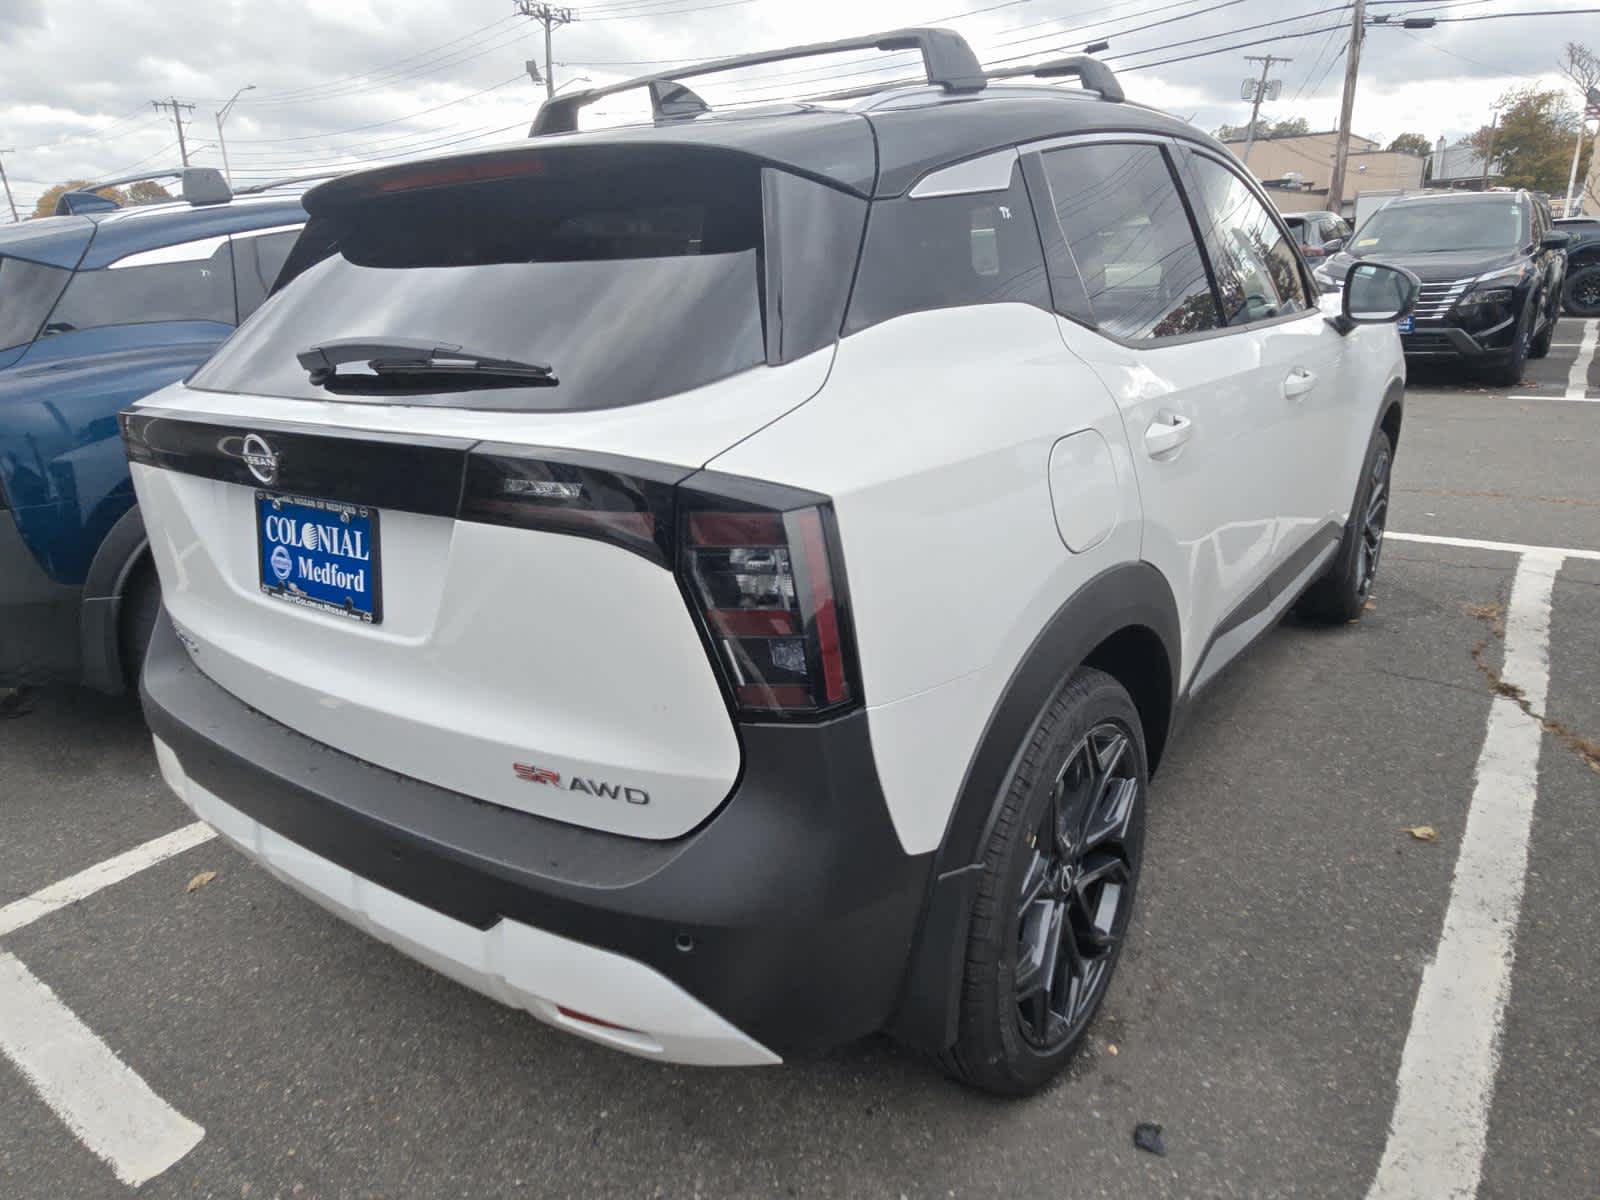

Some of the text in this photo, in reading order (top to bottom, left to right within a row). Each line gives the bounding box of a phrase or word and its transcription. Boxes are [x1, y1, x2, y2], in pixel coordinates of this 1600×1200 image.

[265, 514, 370, 561] COLONIAL
[298, 555, 365, 593] Medford
[569, 776, 650, 806] AWD
